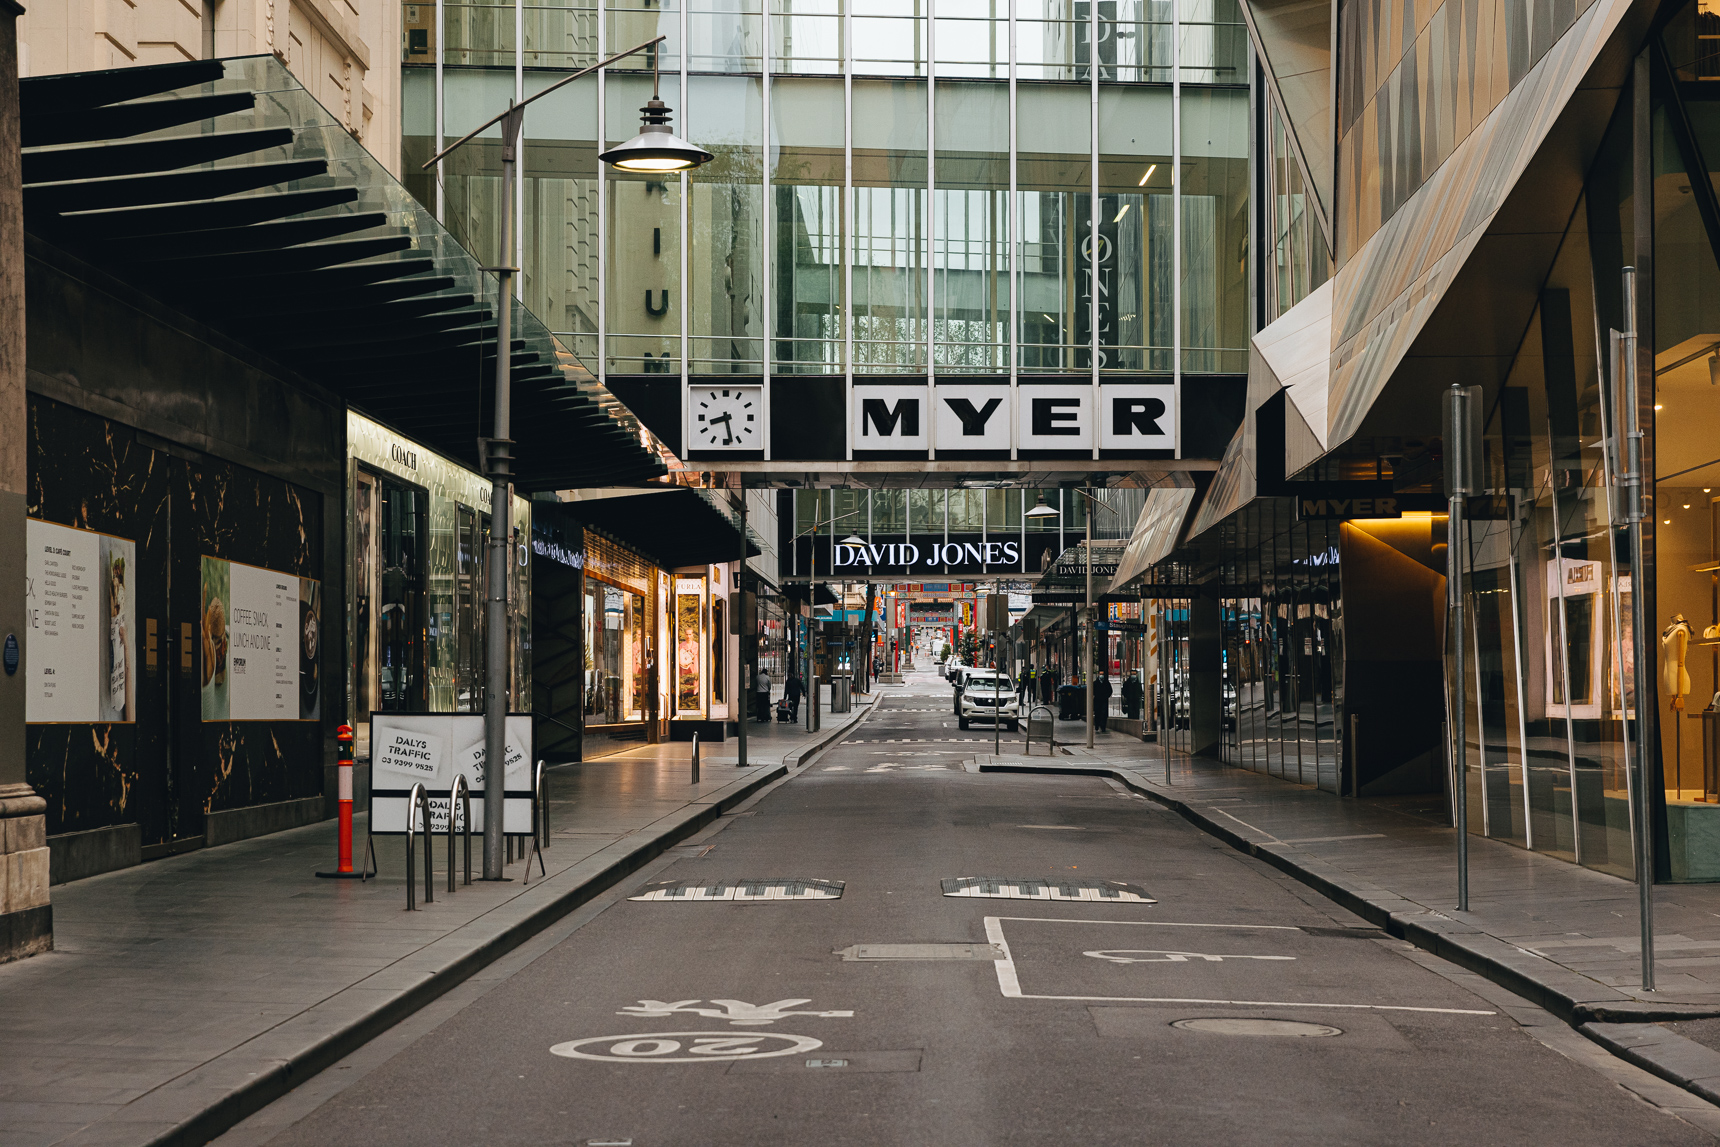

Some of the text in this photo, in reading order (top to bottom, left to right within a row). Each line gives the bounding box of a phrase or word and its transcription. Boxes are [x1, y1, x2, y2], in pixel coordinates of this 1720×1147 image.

[862, 398, 1166, 436] MYER
[391, 443, 417, 471] COACH
[480, 486, 492, 506] COA
[1302, 497, 1398, 516] MYER
[833, 541, 1019, 567] DAVID JONES
[1091, 566, 1118, 575] JONE
[1142, 586, 1196, 597] MYER
[395, 736, 427, 749] DALYS
[388, 746, 432, 761] TRAFFIC
[381, 756, 434, 772] 03 9399 9525
[429, 800, 461, 810] DALS
[610, 1037, 765, 1056] 20
